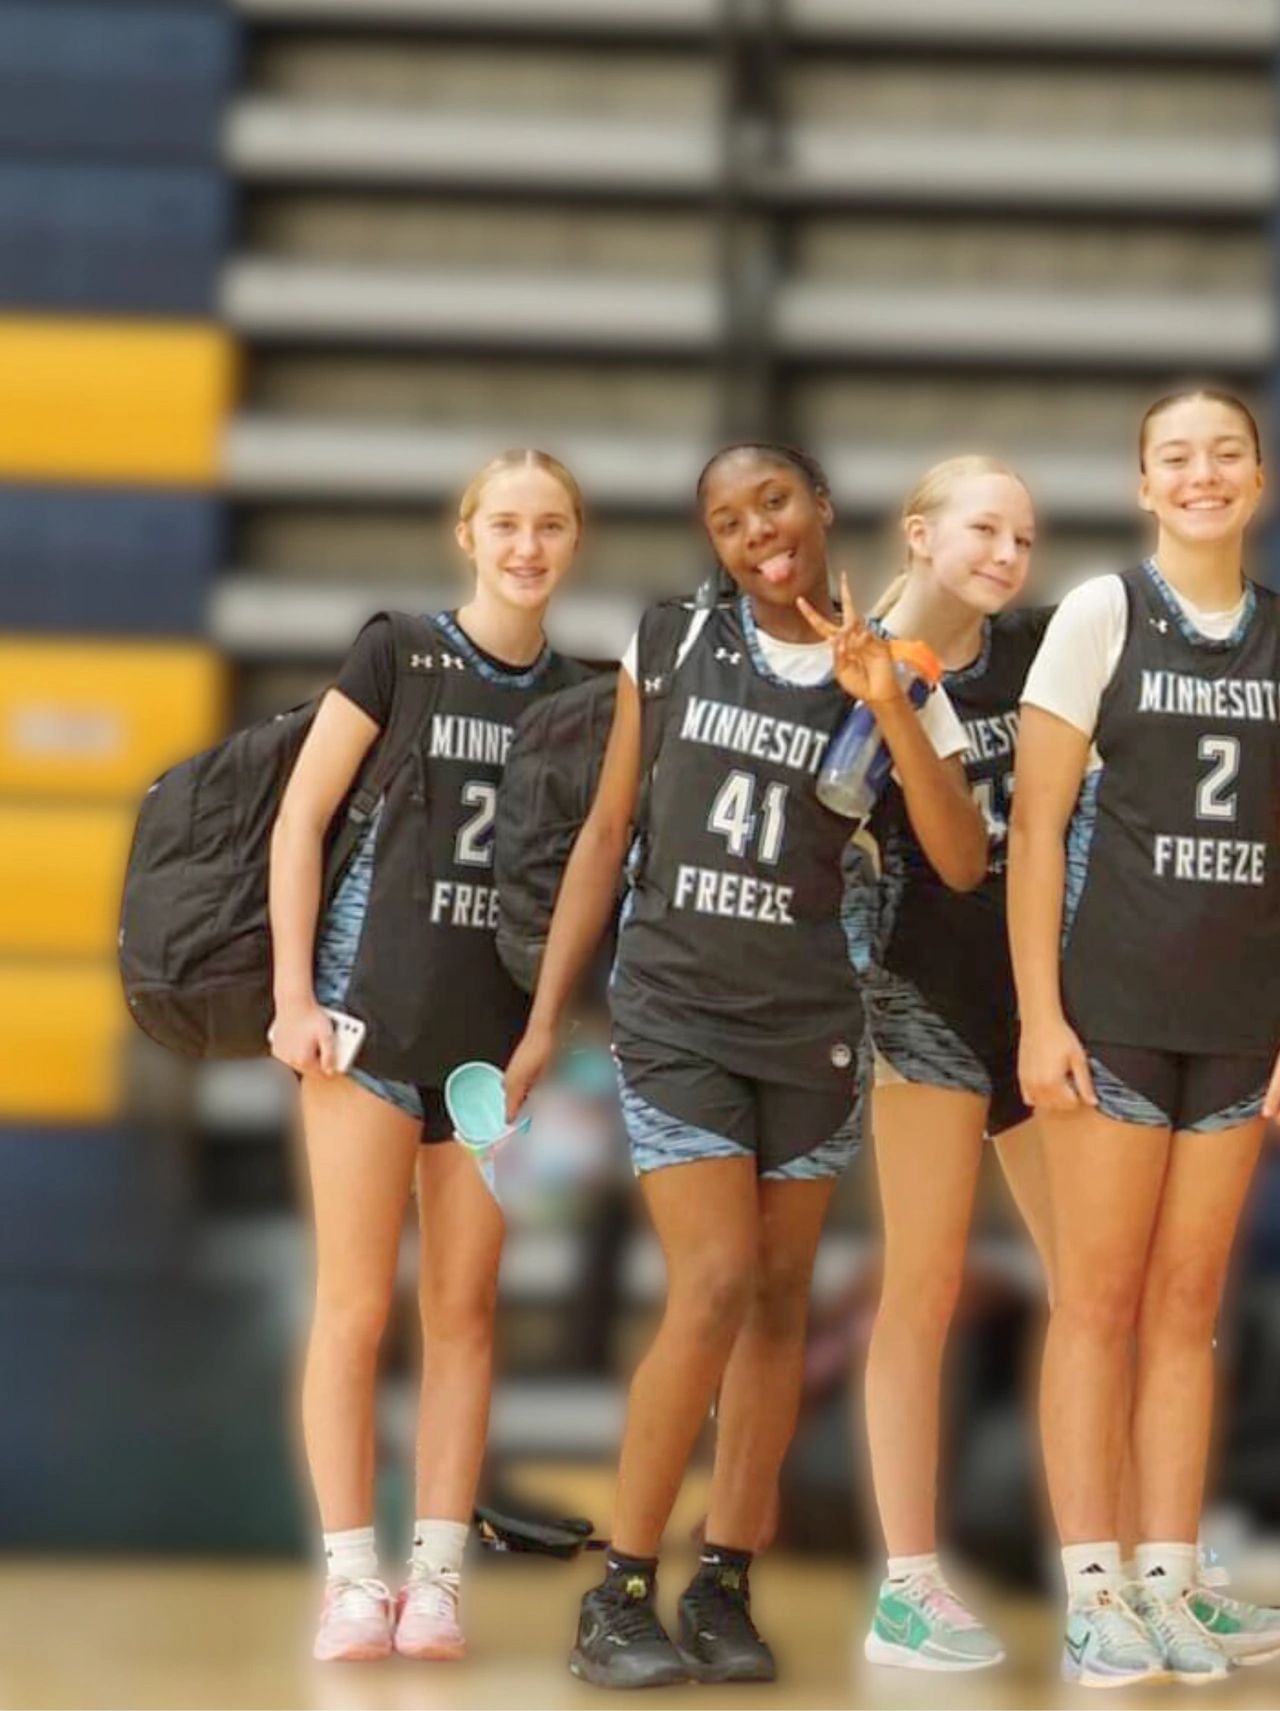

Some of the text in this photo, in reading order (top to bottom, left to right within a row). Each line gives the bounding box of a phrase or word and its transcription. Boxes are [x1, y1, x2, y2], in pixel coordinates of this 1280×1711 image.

[1195, 734, 1240, 821] 2
[707, 769, 789, 865] 41
[673, 864, 795, 925] FREEZE
[1153, 834, 1266, 885] FREEZE
